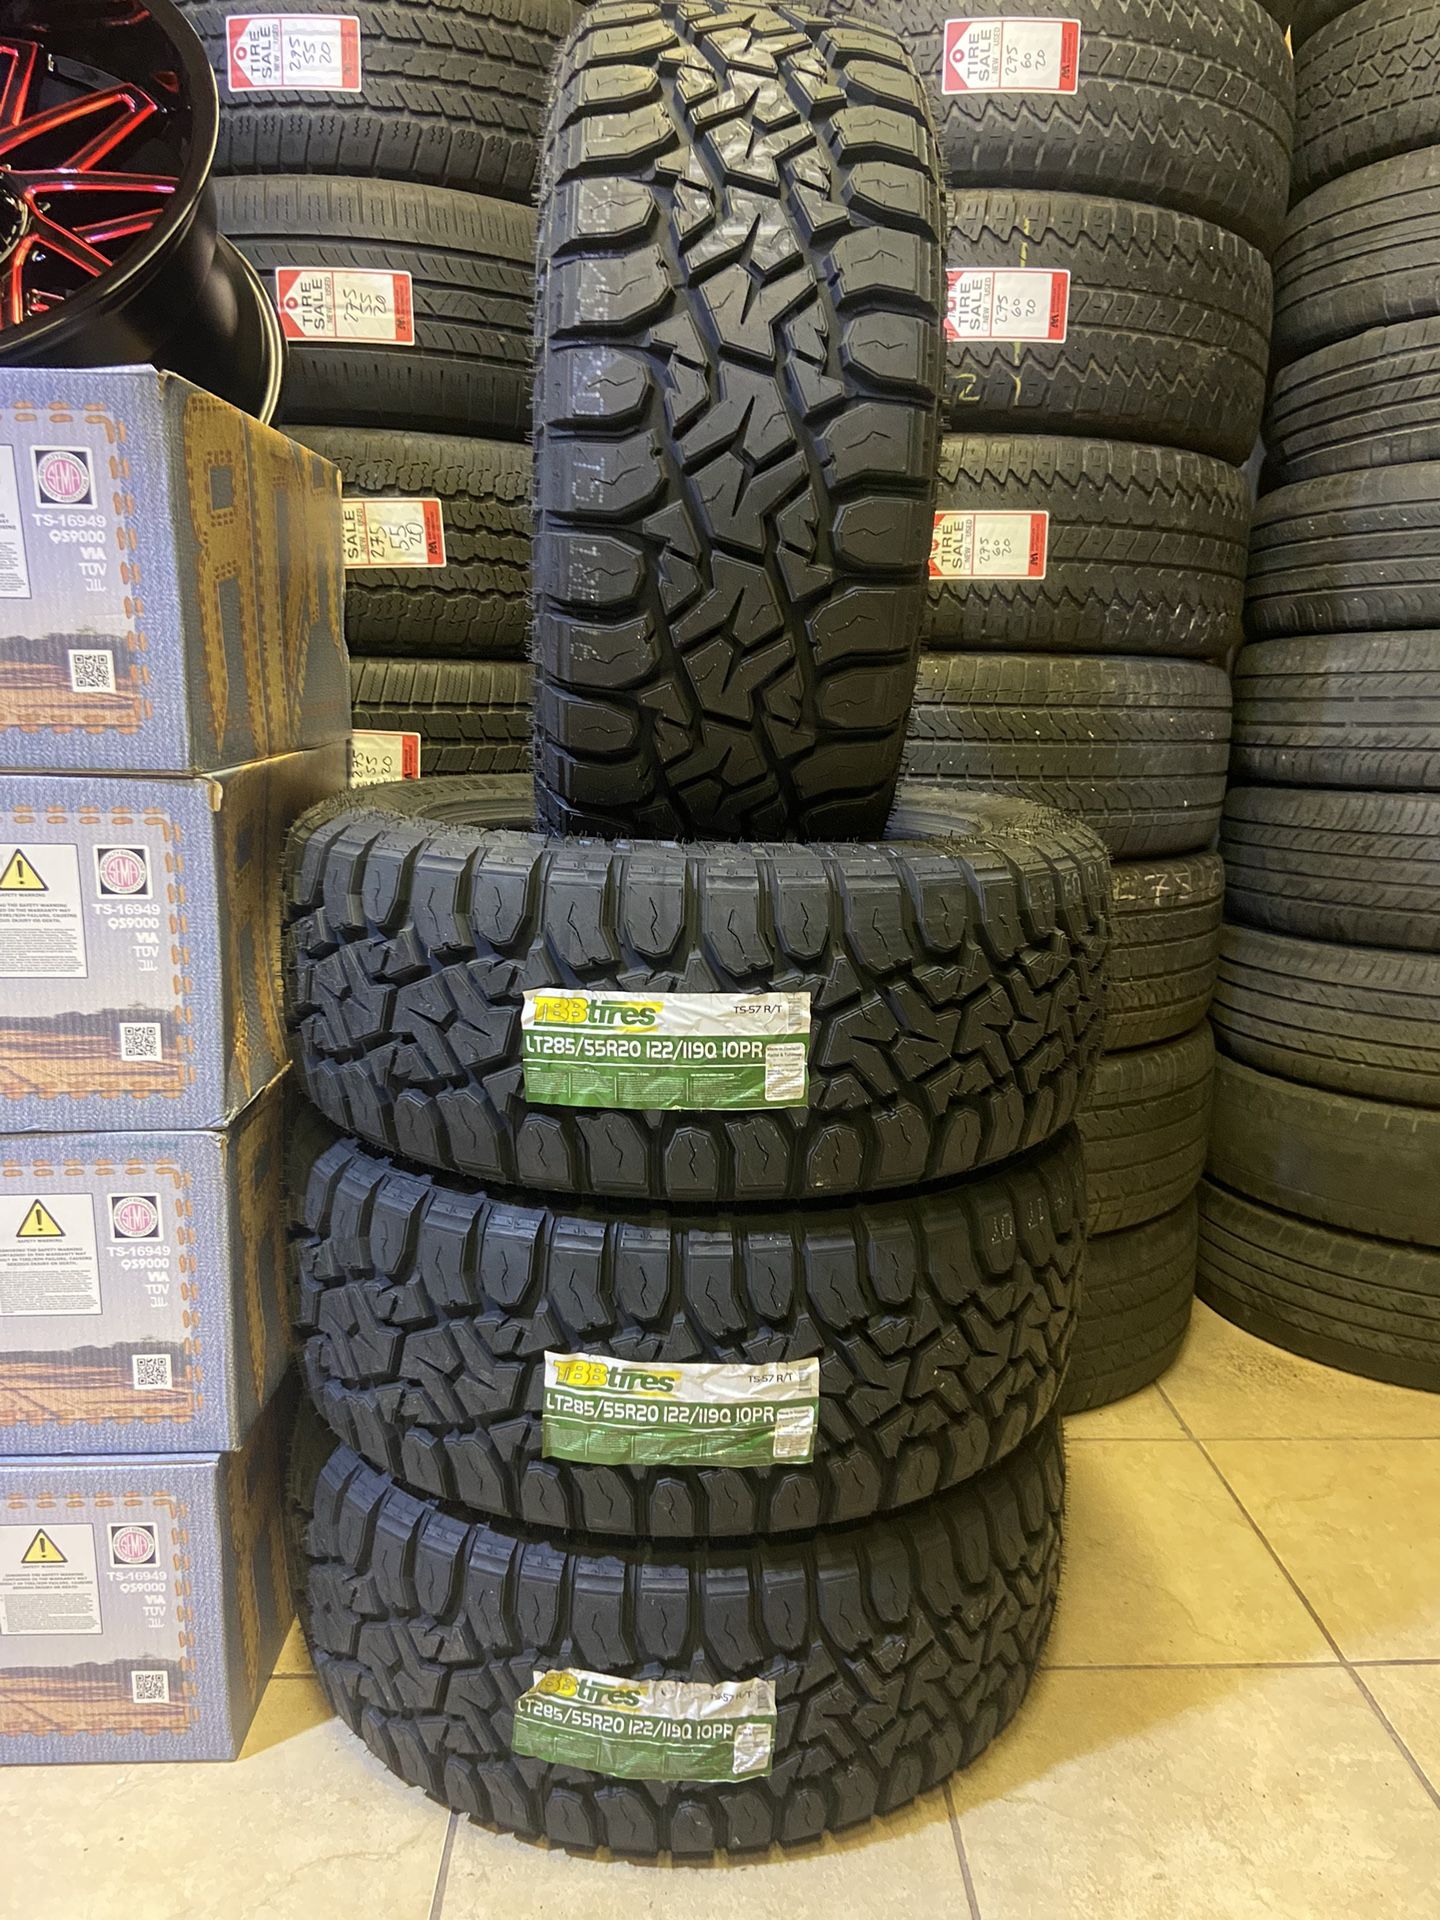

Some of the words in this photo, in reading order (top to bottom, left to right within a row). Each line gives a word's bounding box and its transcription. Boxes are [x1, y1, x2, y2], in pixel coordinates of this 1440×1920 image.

[250, 31, 261, 76] TIRE
[261, 26, 272, 78] SALE
[289, 36, 302, 71] 295
[303, 40, 316, 64] 55
[319, 42, 332, 64] 20
[967, 33, 980, 79] TIRE
[978, 29, 991, 81] SALE
[1005, 44, 1018, 76] 275
[1020, 53, 1031, 69] 60
[1035, 49, 1046, 70] 20
[300, 282, 313, 326] TIRE
[312, 278, 325, 329] SALE
[343, 289, 361, 322] 275
[360, 293, 372, 315] 55
[373, 295, 386, 317] 20
[958, 283, 971, 327] TIRE
[970, 279, 983, 330] SALE
[995, 295, 1008, 325] 275
[1012, 298, 1022, 317] 60
[1026, 299, 1036, 317] 20
[47, 460, 81, 495] SEMA
[32, 513, 106, 528] TS-16949
[49, 529, 106, 544] QS9000
[345, 510, 359, 558] SALE
[369, 526, 387, 558] 275
[389, 525, 410, 551] 55
[406, 522, 424, 545] 20
[941, 524, 952, 566] TIRE
[952, 521, 964, 568] SALE
[80, 547, 107, 561] VIA
[979, 537, 990, 564] 275
[993, 540, 1001, 556] 60
[1002, 538, 1012, 556] 20
[352, 750, 364, 778] 275
[366, 755, 378, 775] 55
[381, 756, 392, 774] 20
[108, 858, 138, 887] SEMA
[92, 904, 161, 916] TS-16949
[108, 917, 159, 930] QS9000
[135, 932, 159, 944] VIA
[533, 996, 658, 1028] TBBtires
[733, 1005, 761, 1015] TS-57
[764, 1003, 783, 1014] R/T
[525, 1035, 641, 1059] LT285/55R20
[646, 1039, 717, 1061] 122/119Q
[722, 1041, 763, 1059] 10PR
[121, 1205, 152, 1231] SEMA
[106, 1246, 171, 1257] TS-16949
[121, 1258, 169, 1270] QS9000
[147, 1271, 169, 1282] VIA
[553, 1359, 676, 1393] TBBtires
[776, 1372, 793, 1383] R/T
[546, 1392, 659, 1421] LT285/55R20
[663, 1405, 731, 1424] 122/119Q
[736, 1406, 775, 1422] 10PR
[121, 1534, 148, 1558] SEMA
[106, 1571, 167, 1582] TS-16949
[120, 1583, 166, 1594] QS9000
[144, 1594, 166, 1605] VIA
[539, 1673, 642, 1706] BBtires
[517, 1699, 625, 1733] LT285/55R20
[628, 1718, 693, 1740] 122/119Q
